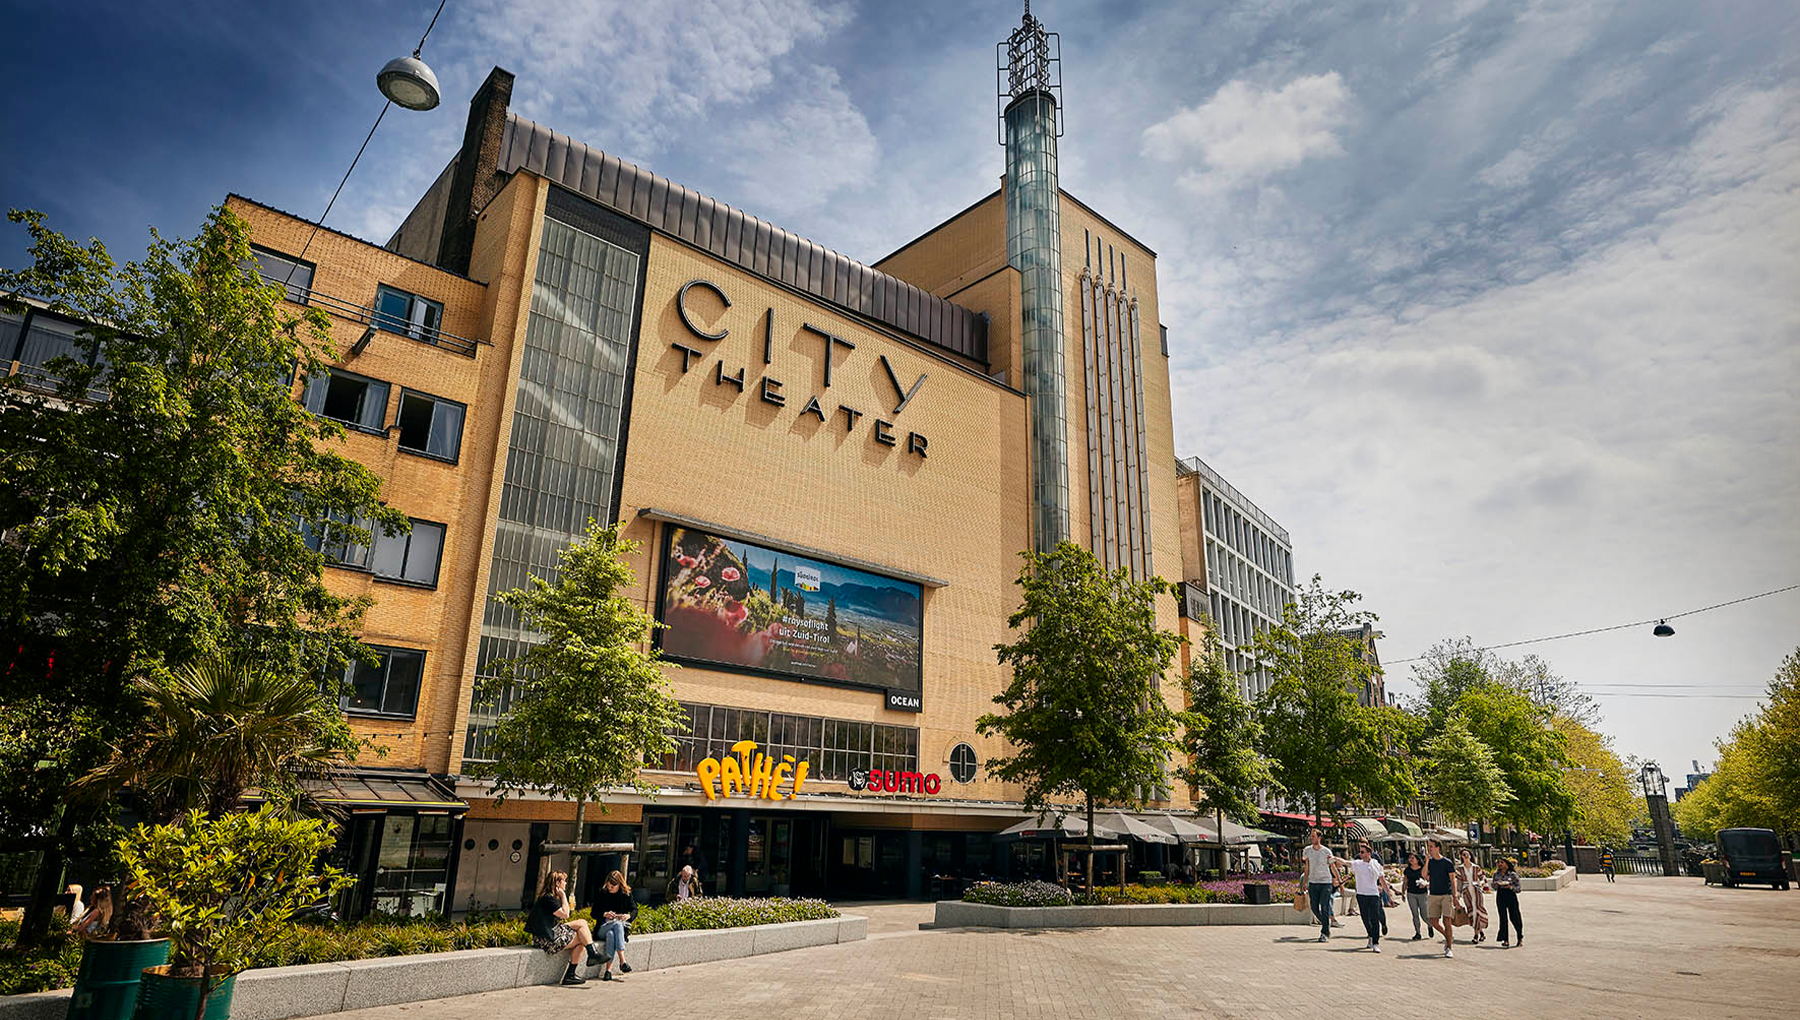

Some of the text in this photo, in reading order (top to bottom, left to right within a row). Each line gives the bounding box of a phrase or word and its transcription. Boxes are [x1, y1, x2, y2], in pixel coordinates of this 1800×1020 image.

[677, 279, 927, 413] CITY
[671, 342, 928, 458] THEATER
[782, 615, 829, 630] #raysoflight
[778, 627, 830, 643] uit Zuid-Tirol
[890, 695, 920, 708] OCEAN
